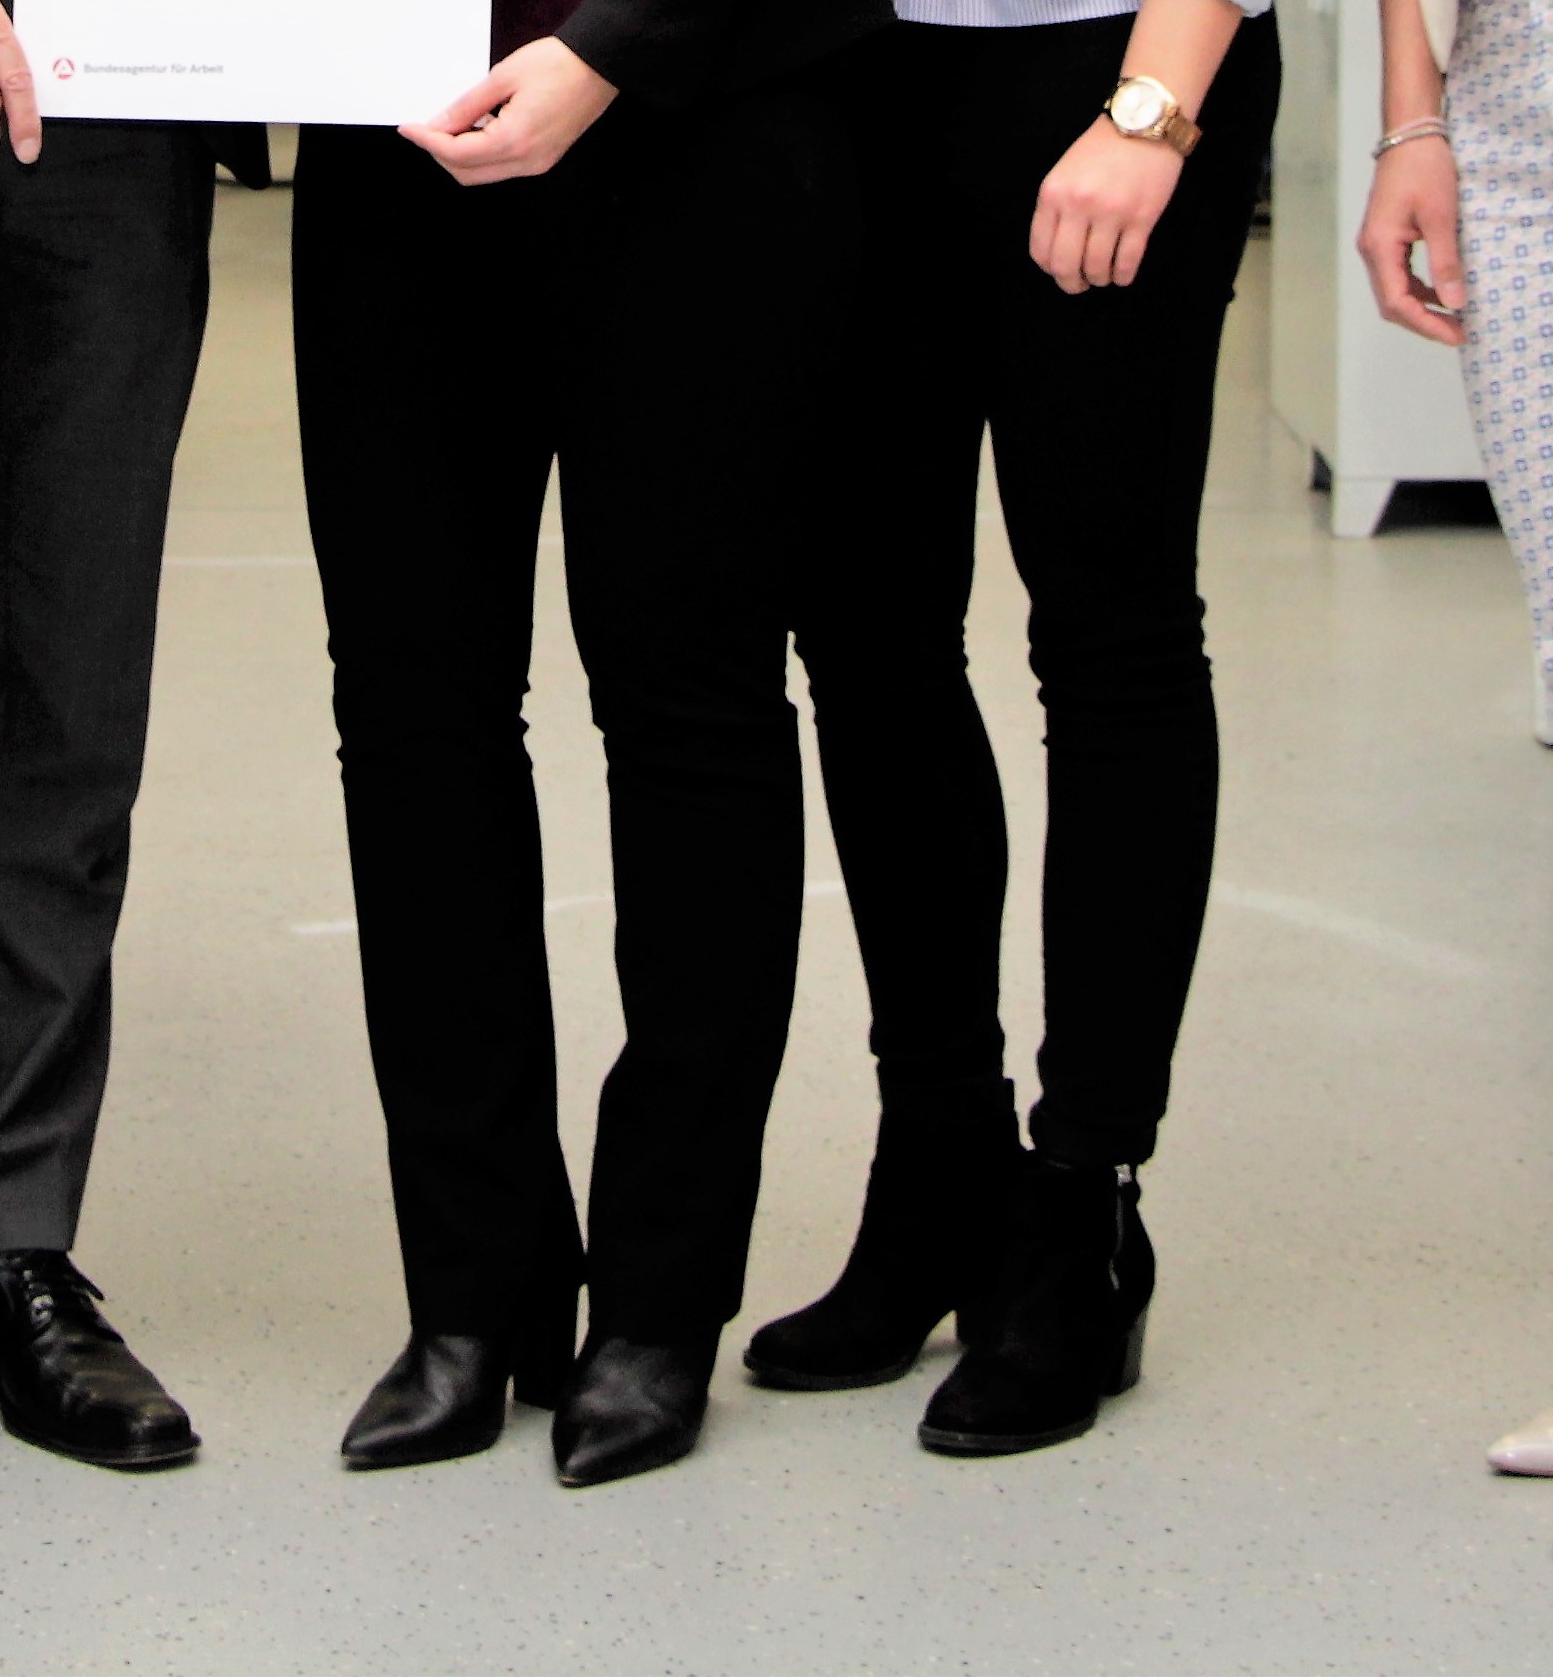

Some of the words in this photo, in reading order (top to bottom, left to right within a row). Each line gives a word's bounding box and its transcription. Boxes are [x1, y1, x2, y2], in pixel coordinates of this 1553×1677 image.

[83, 63, 167, 76] Bundesagentur
[171, 63, 186, 74] für
[189, 64, 224, 74] Arbeit
